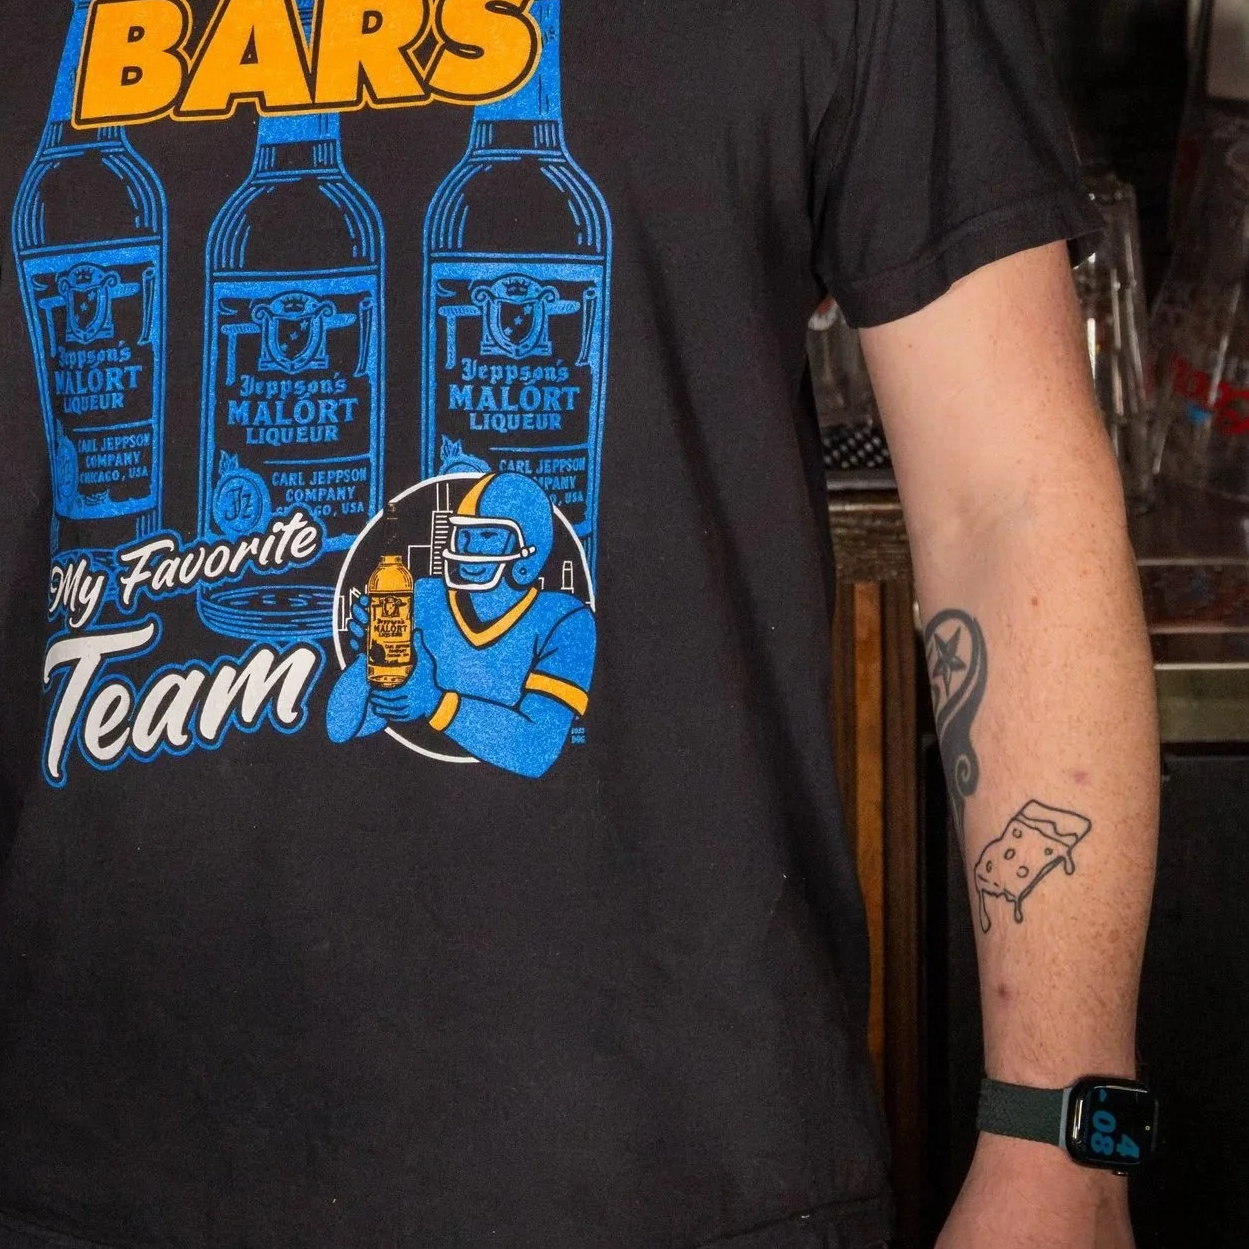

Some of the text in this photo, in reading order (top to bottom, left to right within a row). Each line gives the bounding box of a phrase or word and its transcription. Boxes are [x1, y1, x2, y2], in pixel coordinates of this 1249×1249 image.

[461, 358, 570, 384] Jeppson's
[239, 372, 348, 398] Jeppson's
[469, 412, 563, 433] LIQUEUR
[101, 433, 150, 451] JEPPSON
[246, 425, 340, 446] LIQUEUR
[86, 452, 141, 468] COMPANY
[499, 457, 586, 474] CARL JEPPSON
[128, 466, 149, 478] USA
[272, 468, 367, 487] CARL JEPPSON
[285, 486, 356, 503] COMPANY
[565, 491, 585, 505] USA
[342, 501, 364, 515] USA
[49, 513, 318, 628] My Favorite
[44, 622, 316, 778] Team
[1090, 1110, 1117, 1156] 08
[1116, 1134, 1141, 1159] 4
